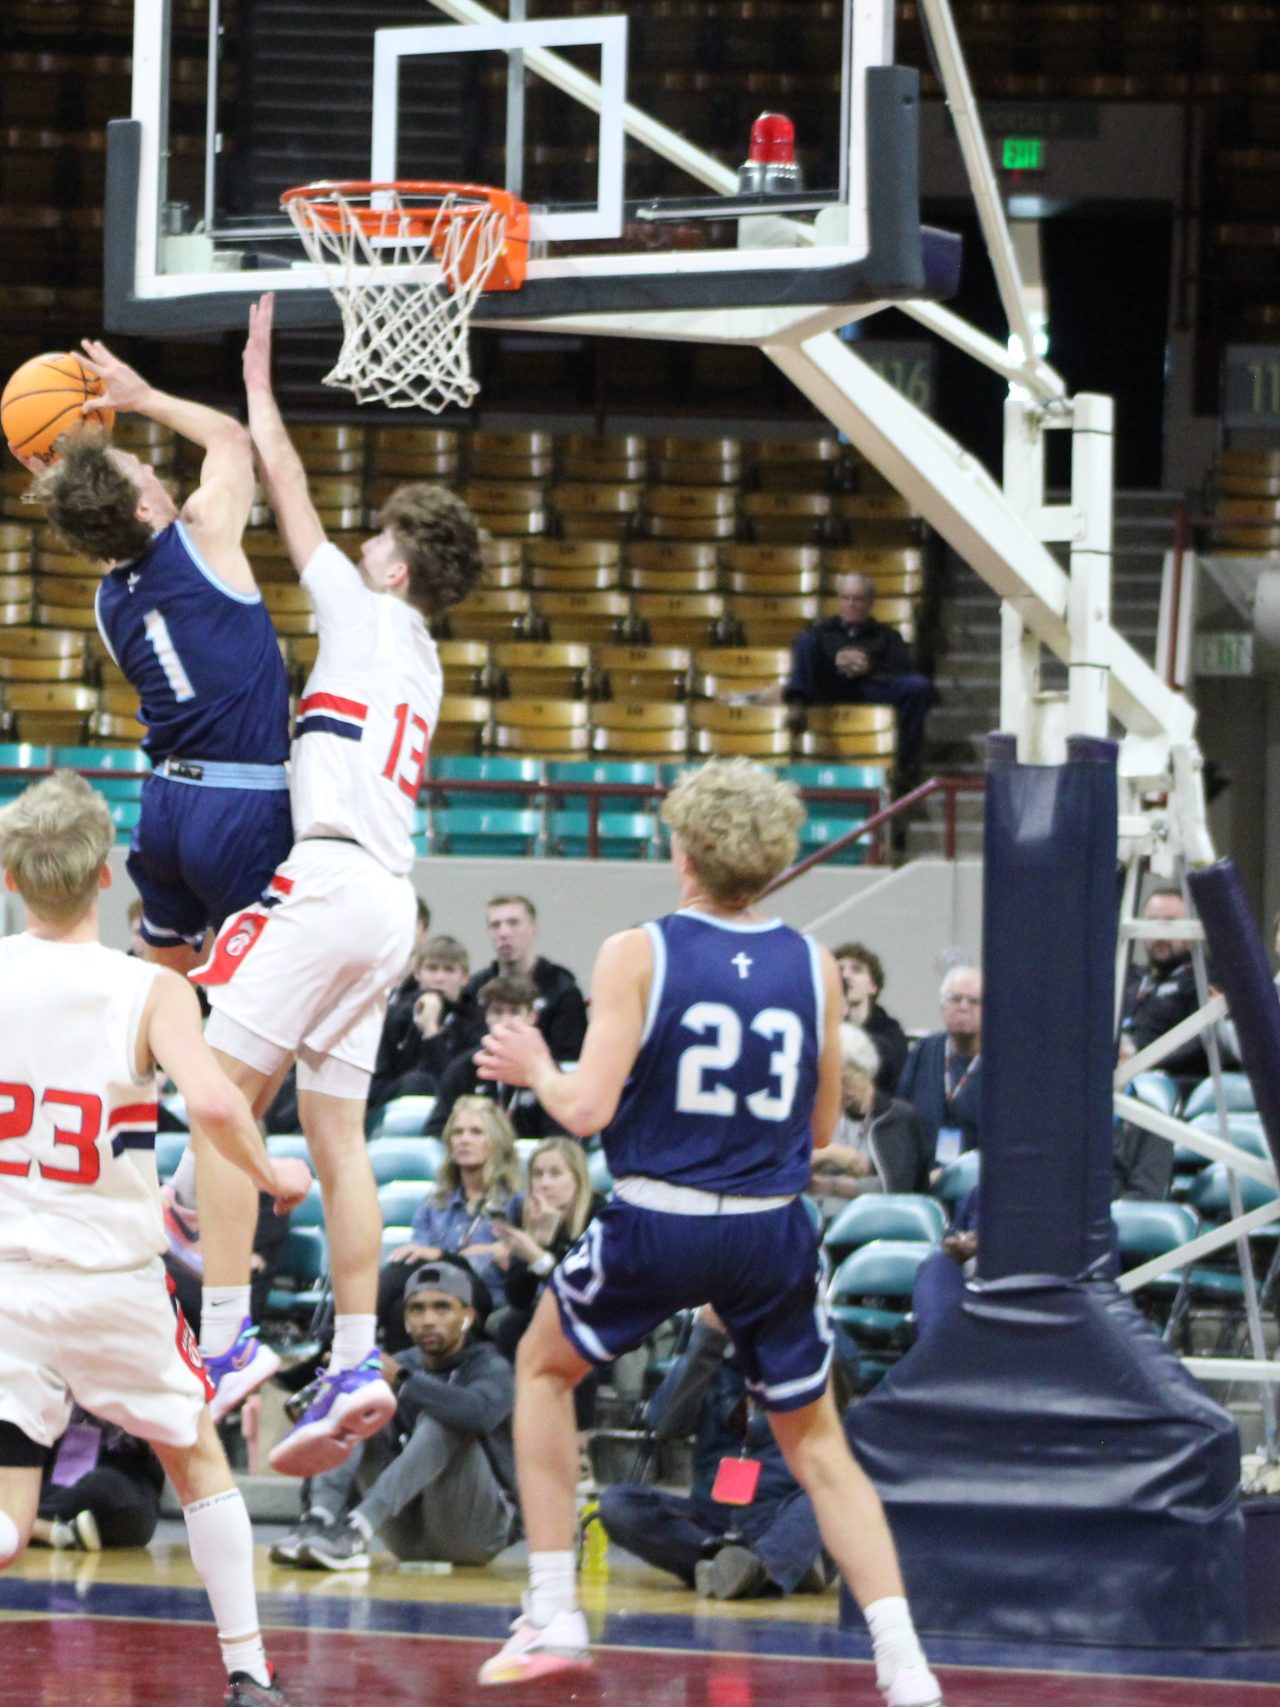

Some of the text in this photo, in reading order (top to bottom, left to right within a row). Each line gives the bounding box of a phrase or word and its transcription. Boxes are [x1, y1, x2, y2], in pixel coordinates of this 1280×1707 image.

[143, 609, 196, 703] 1
[381, 702, 430, 801] 13
[676, 1001, 804, 1122] 23
